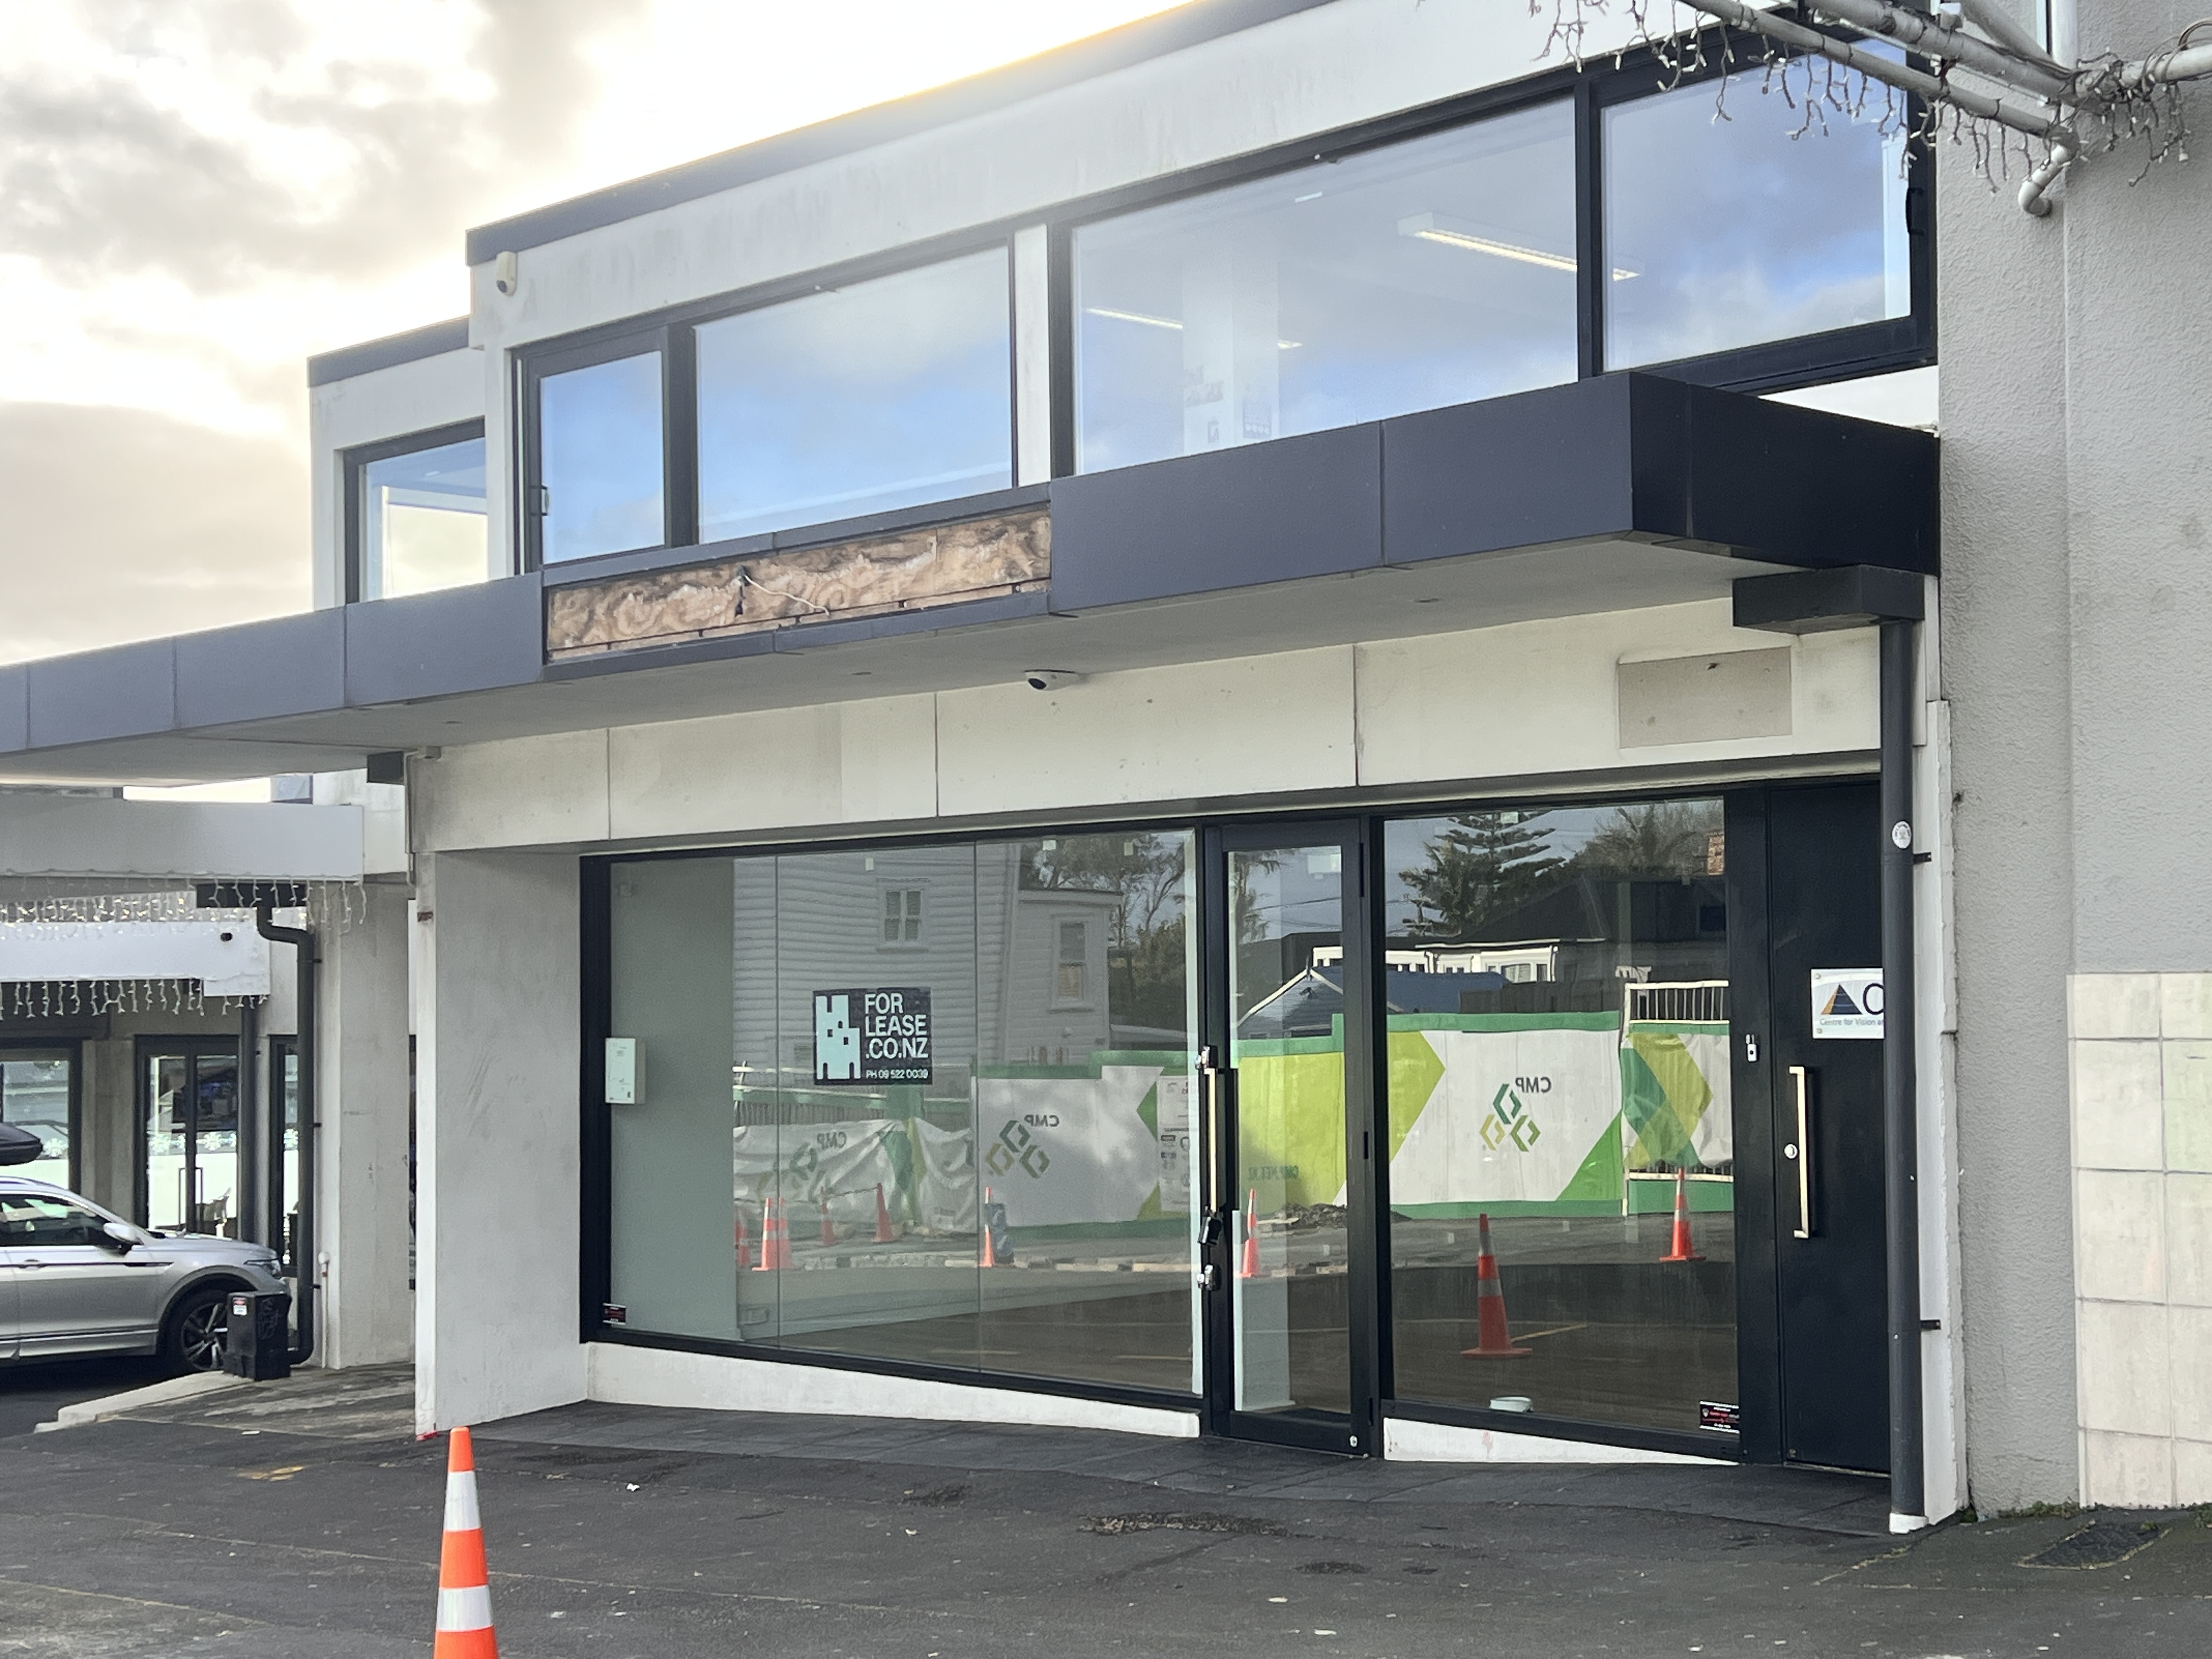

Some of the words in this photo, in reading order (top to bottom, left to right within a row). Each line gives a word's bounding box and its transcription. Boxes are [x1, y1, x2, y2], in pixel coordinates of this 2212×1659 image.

[865, 993, 903, 1014] FOR
[865, 1014, 927, 1037] LEASE
[865, 1038, 928, 1059] .CO.NZ
[866, 1070, 877, 1079] PH
[878, 1069, 889, 1079] 09
[890, 1069, 905, 1079] 522
